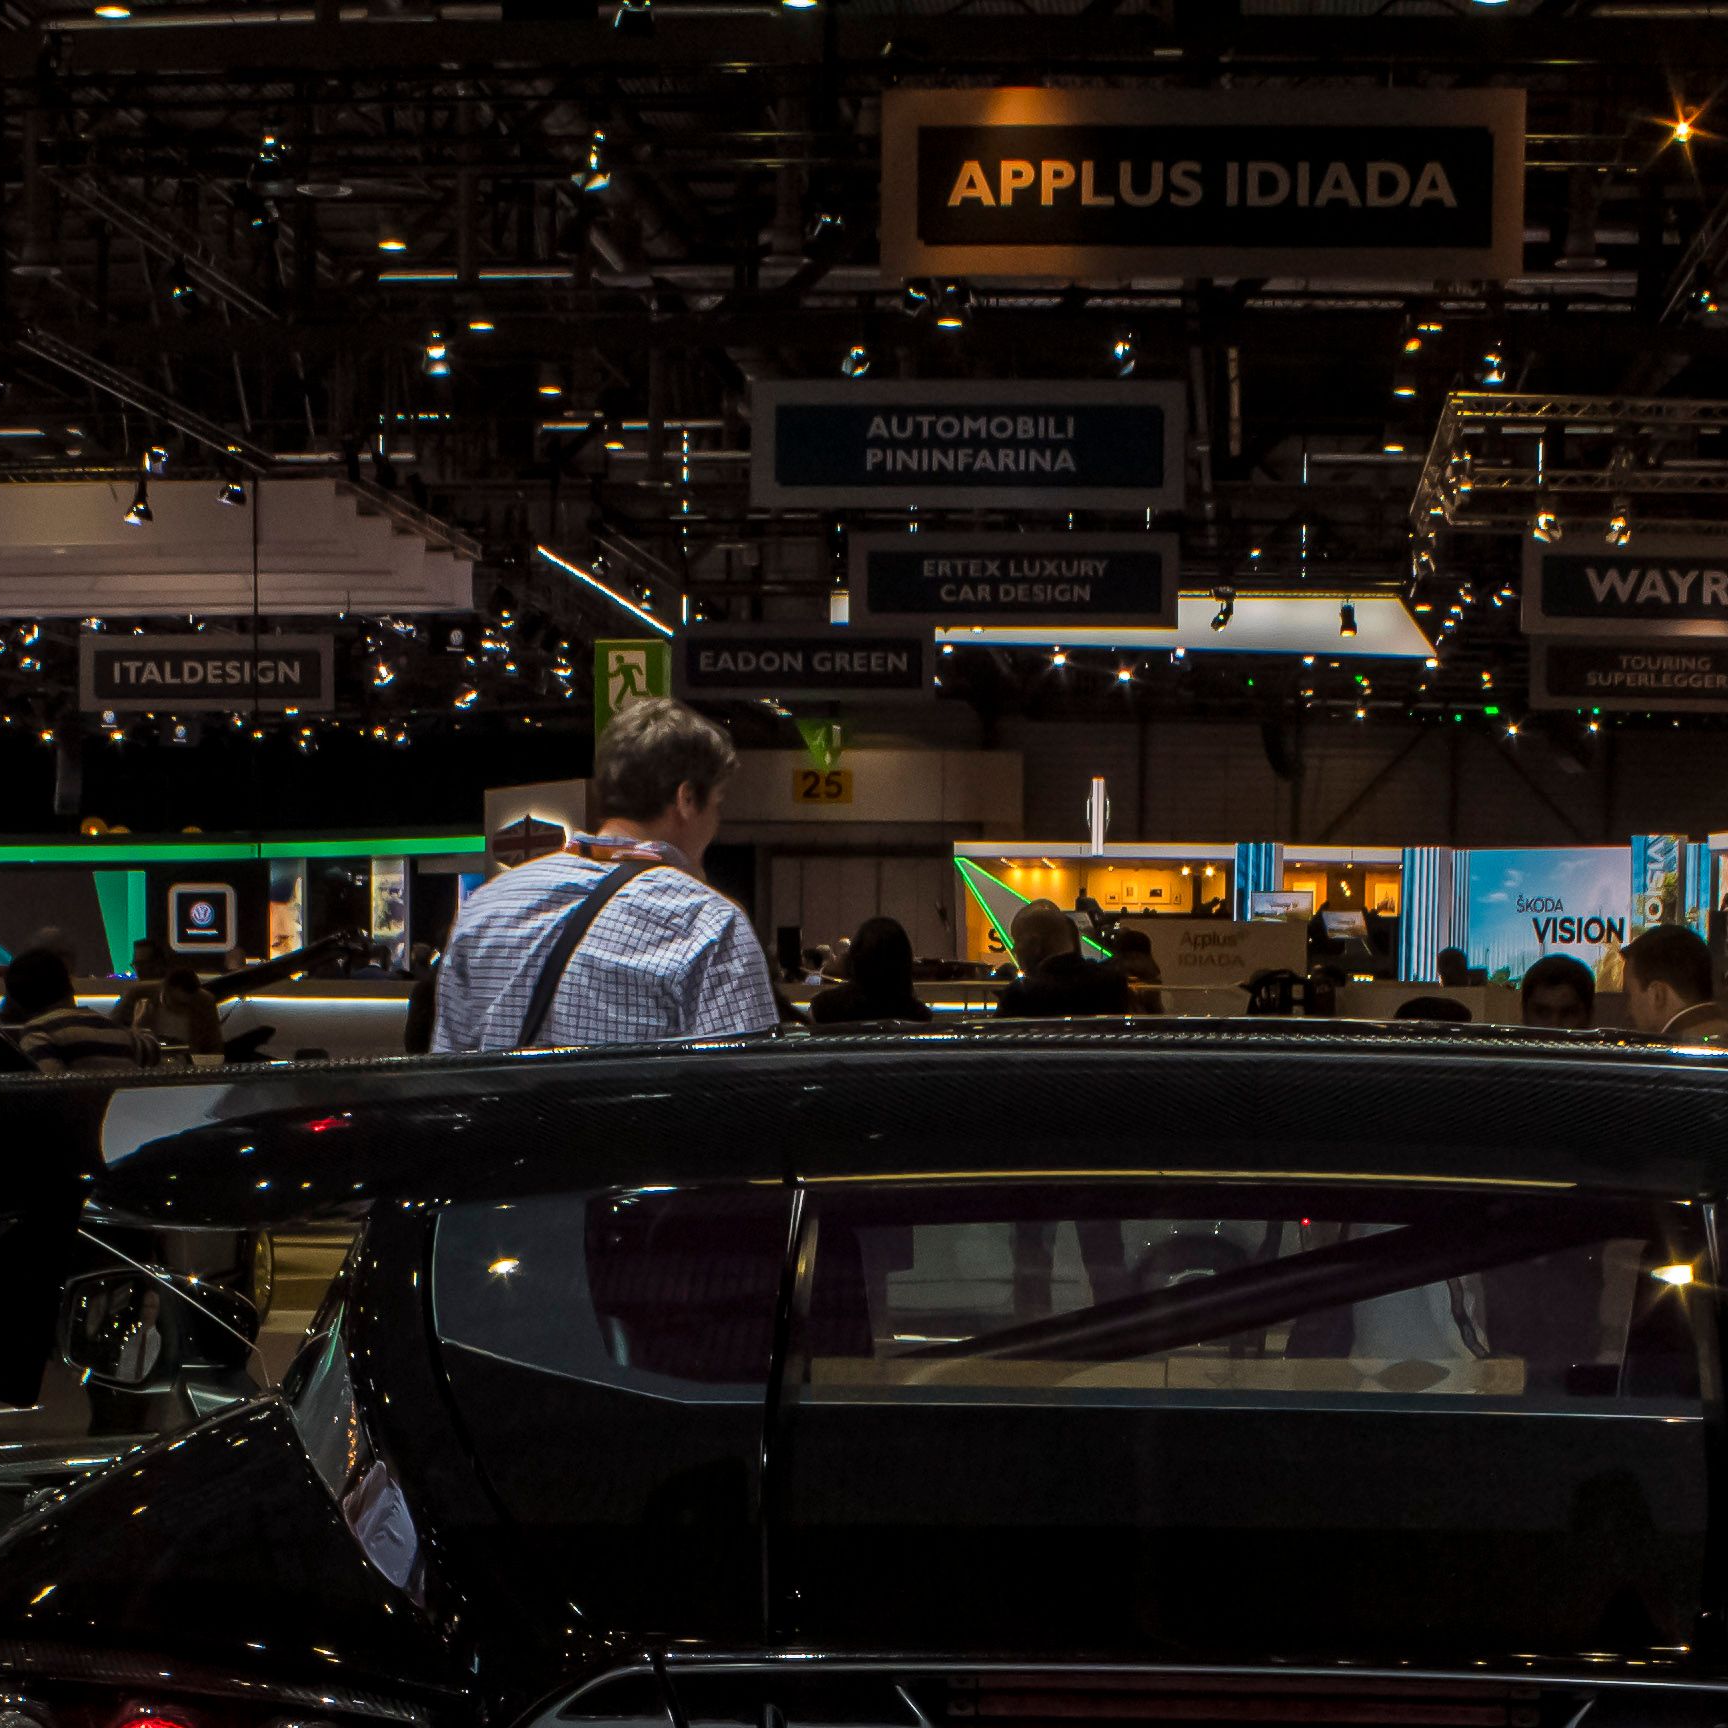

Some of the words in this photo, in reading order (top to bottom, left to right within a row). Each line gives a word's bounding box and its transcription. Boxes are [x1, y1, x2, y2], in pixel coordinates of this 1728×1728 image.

[947, 158, 1203, 208] APPLUS
[1224, 159, 1457, 209] IDIADA
[865, 415, 1075, 441] AUTOMOBILI
[865, 447, 1076, 473] PININFARINA
[922, 559, 1000, 578] ERTEX
[1009, 559, 1108, 579] LUXURY
[939, 583, 993, 603] CAR
[999, 583, 1091, 603] DESIGN
[113, 660, 300, 685] ITALDESIGN
[699, 650, 802, 673] EADON
[813, 650, 909, 673] GREEN
[1619, 655, 1712, 672] TOURING
[1532, 916, 1625, 945] VISION
